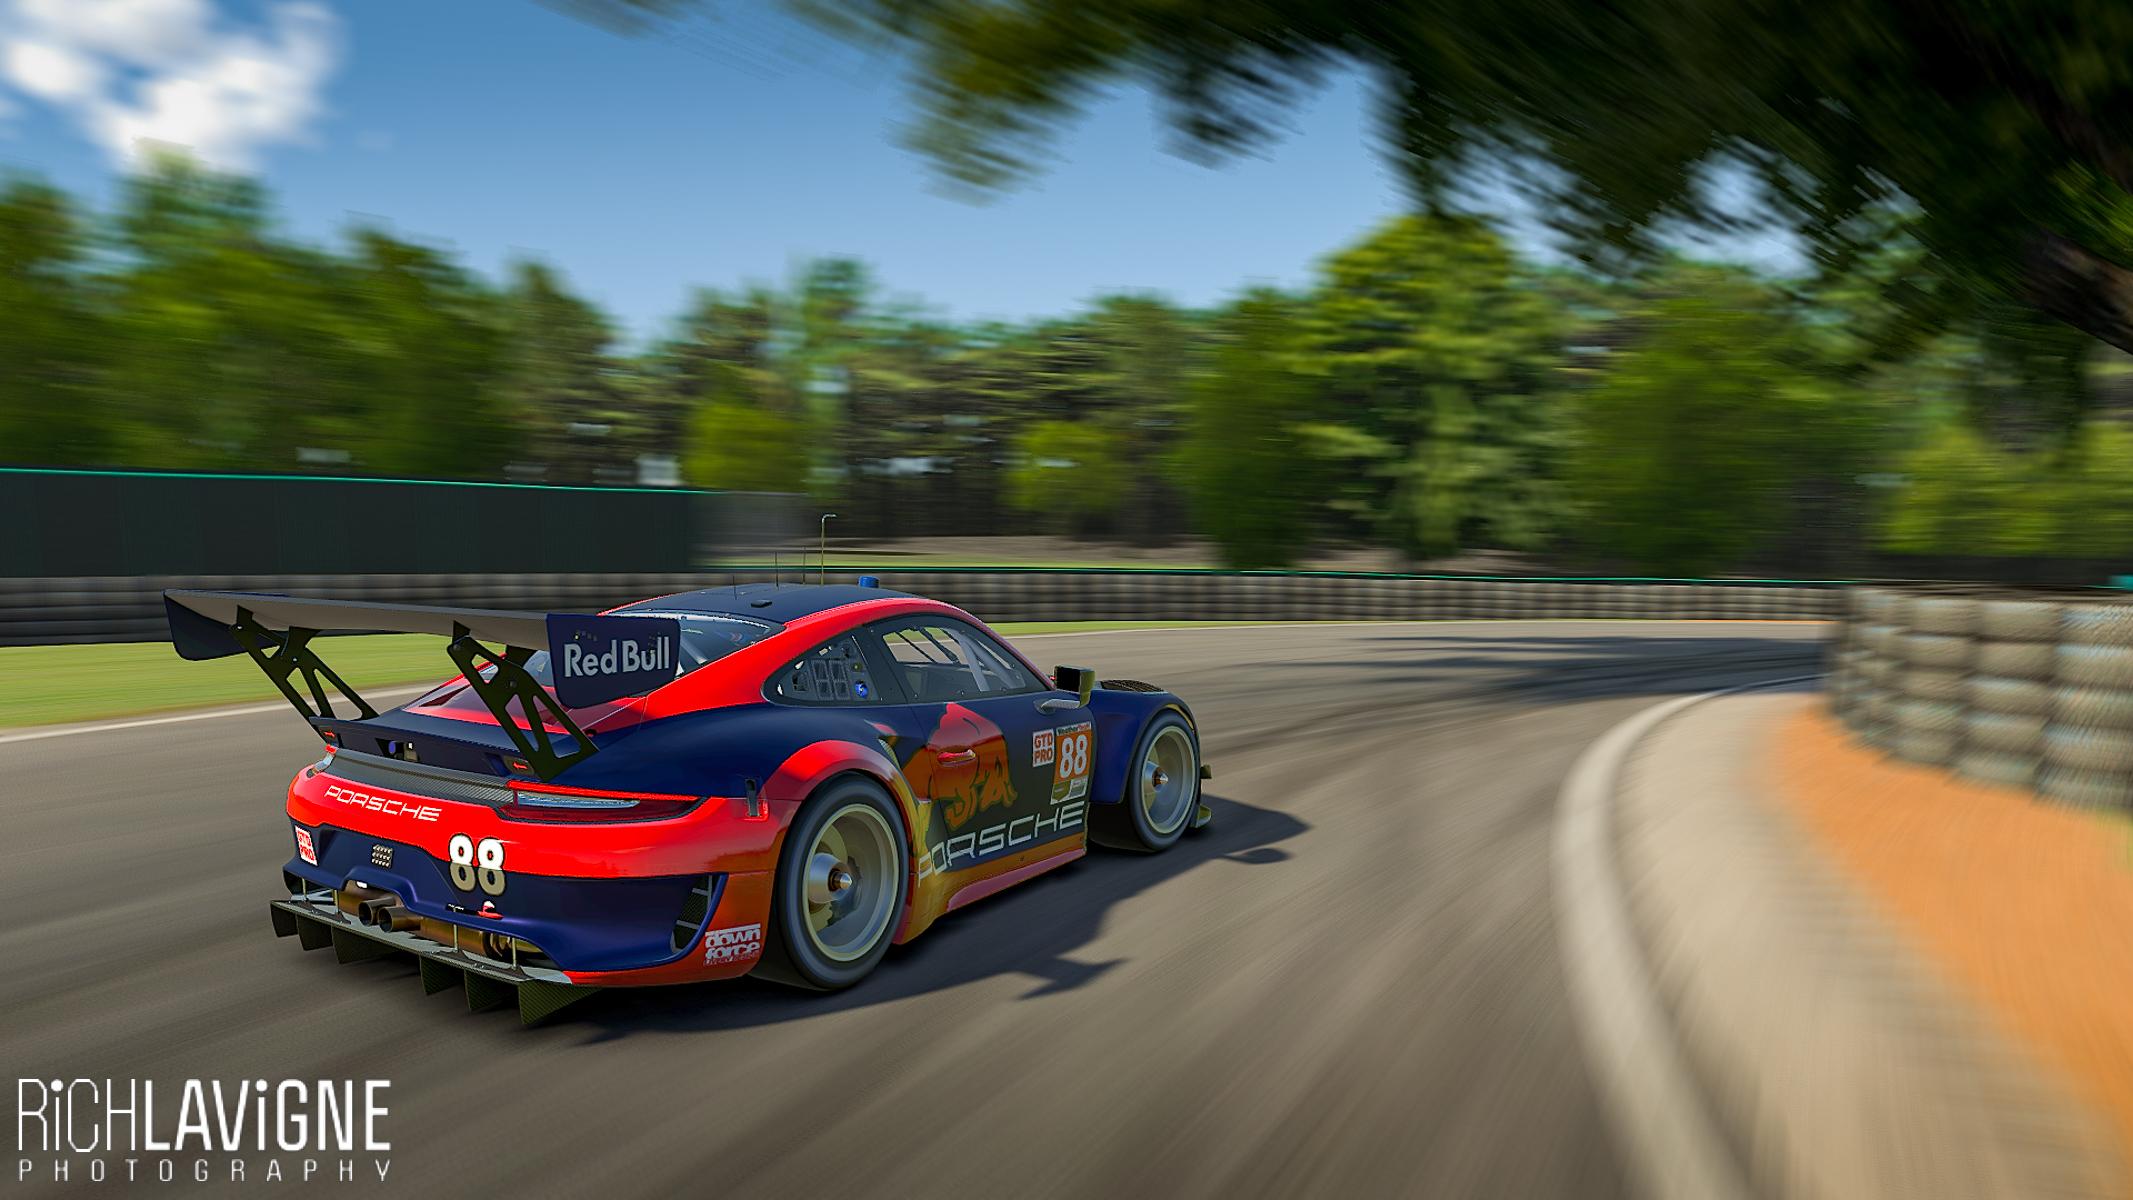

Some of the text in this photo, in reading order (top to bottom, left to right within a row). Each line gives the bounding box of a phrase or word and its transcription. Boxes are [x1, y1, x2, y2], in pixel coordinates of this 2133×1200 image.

[564, 636, 670, 678] Red Bull
[1034, 732, 1054, 749] GTD
[1034, 748, 1053, 764] PRO
[1059, 734, 1088, 779] 88
[324, 785, 442, 822] PORSCHE
[918, 801, 1085, 888] PORSCHE
[449, 833, 507, 896] 88
[705, 928, 761, 949] down
